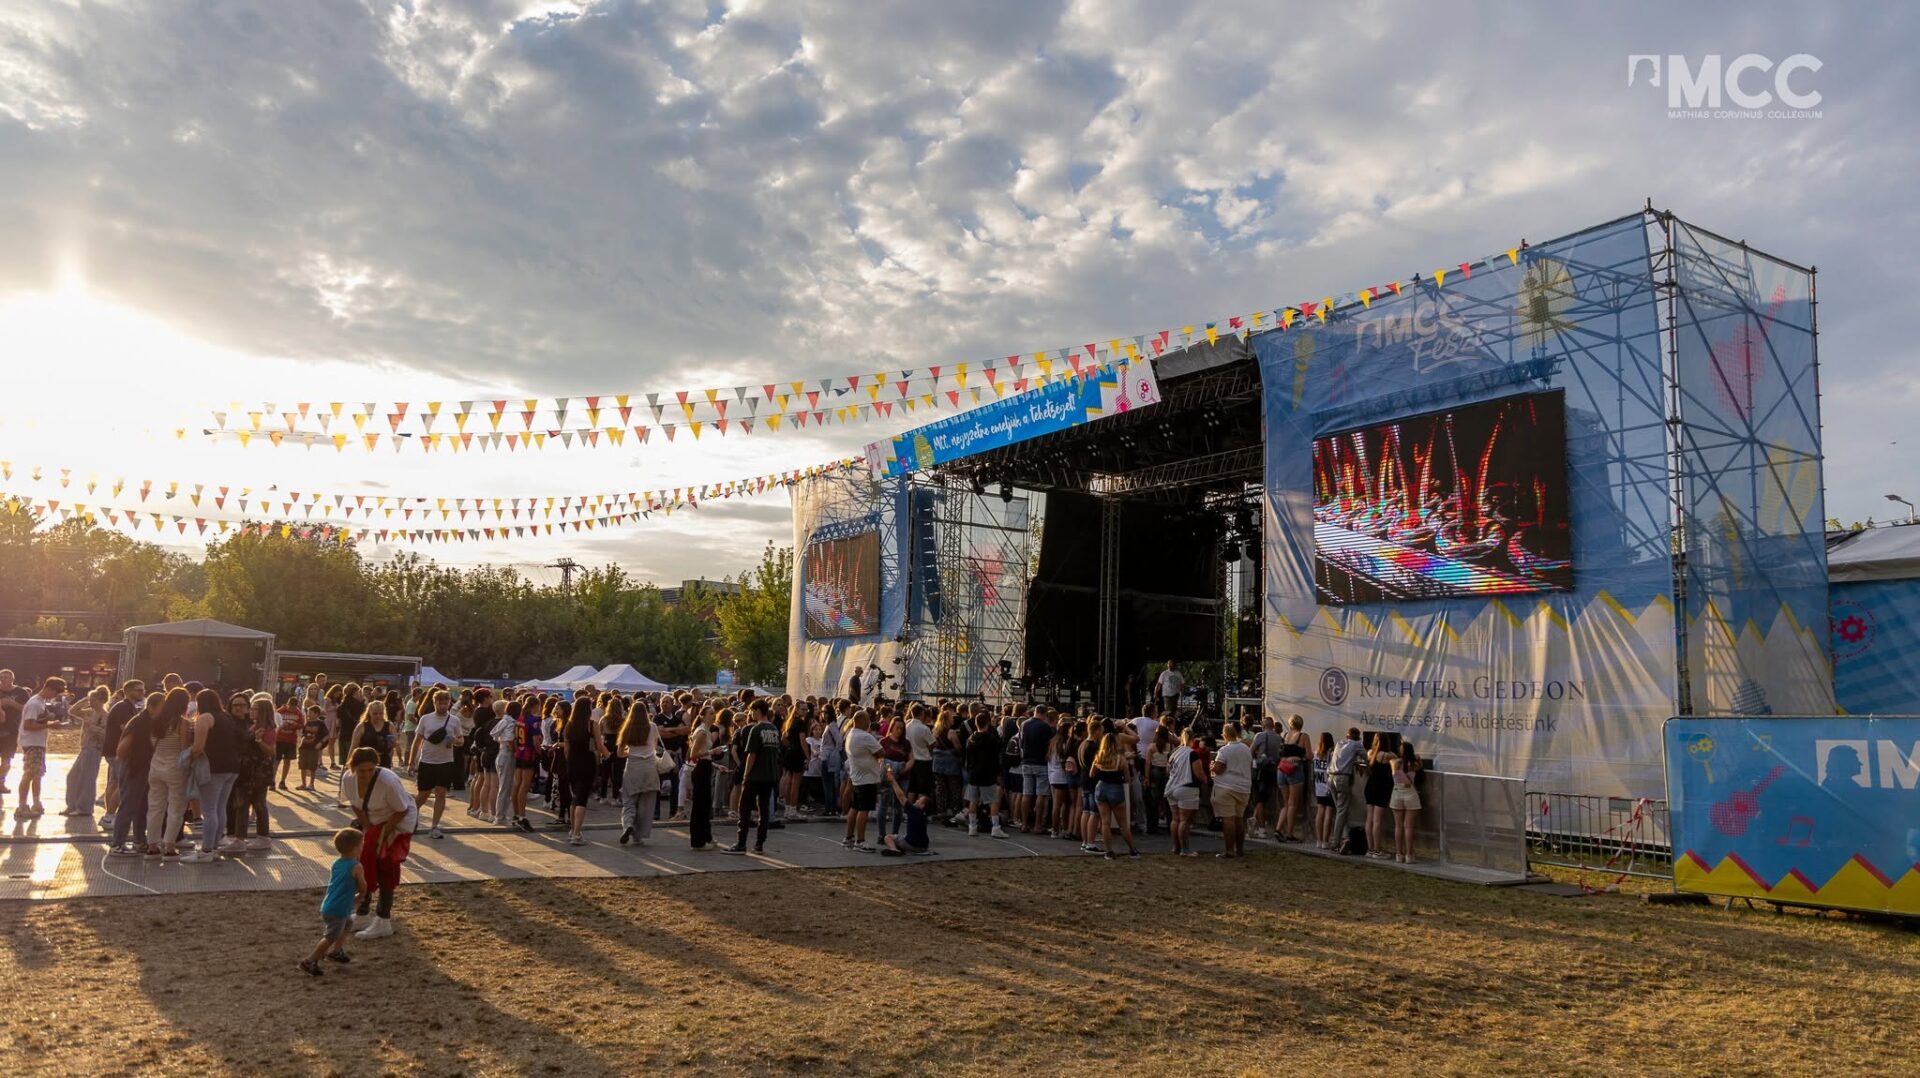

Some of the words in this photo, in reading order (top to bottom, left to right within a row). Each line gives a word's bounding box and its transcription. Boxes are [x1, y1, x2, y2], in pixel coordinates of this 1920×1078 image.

[1023, 414, 1030, 424] a
[1360, 711, 1375, 725] Az
[1445, 716, 1452, 728] a
[1457, 712, 1557, 731] küldetésünk
